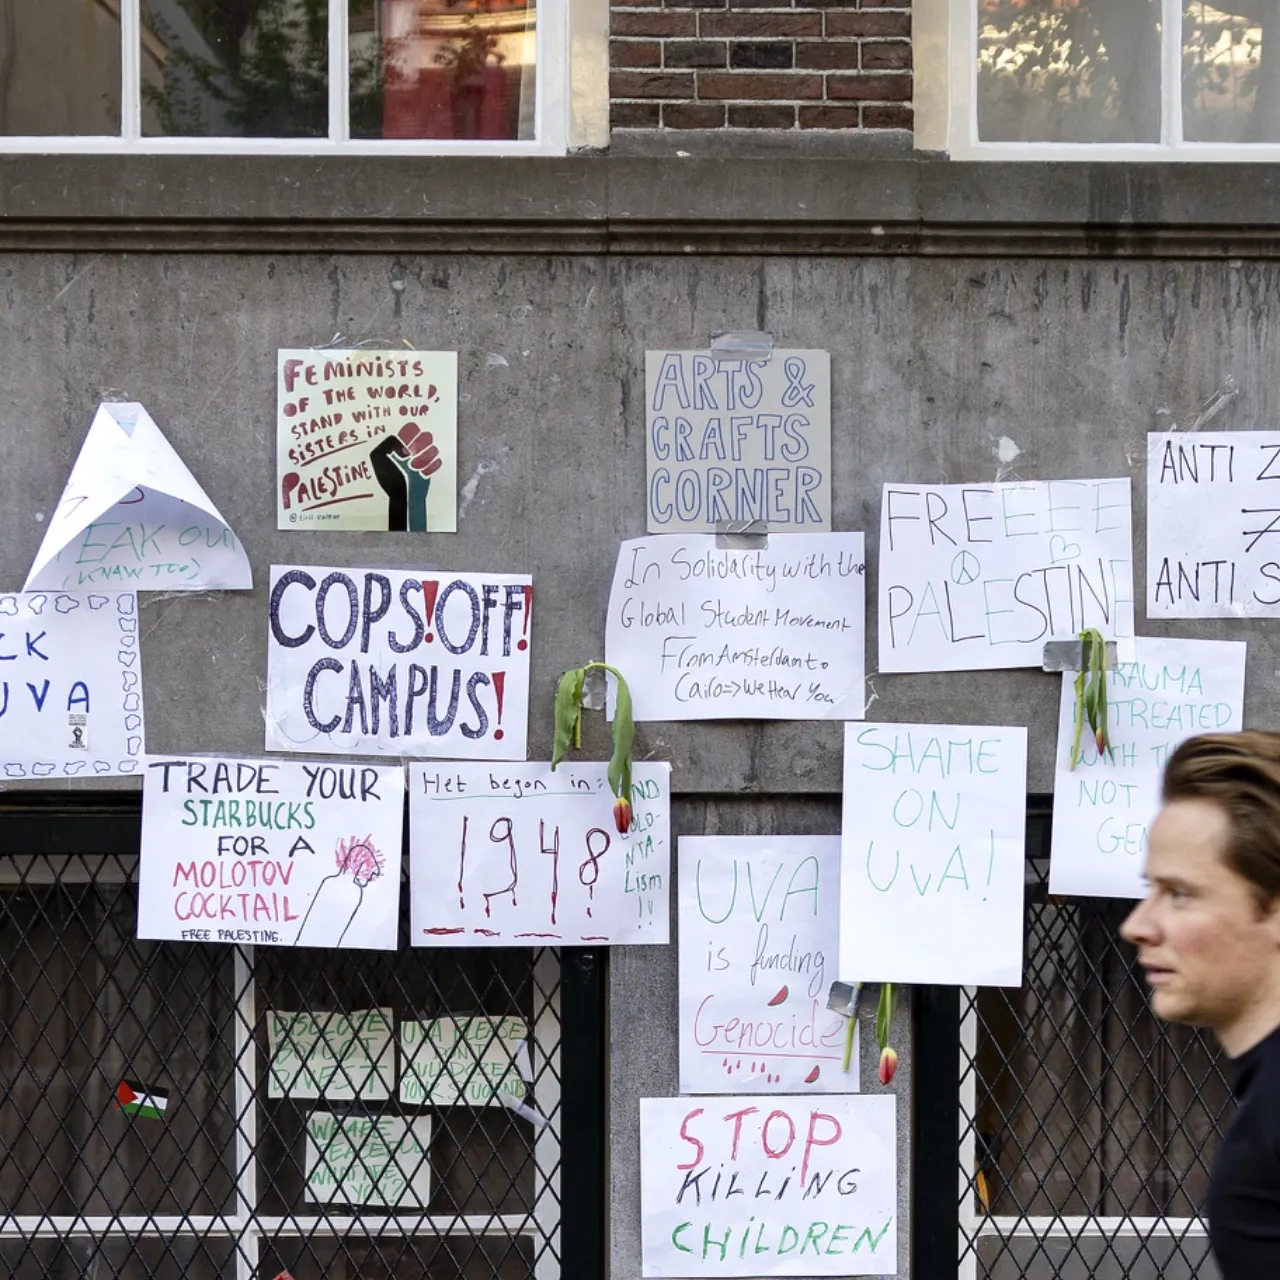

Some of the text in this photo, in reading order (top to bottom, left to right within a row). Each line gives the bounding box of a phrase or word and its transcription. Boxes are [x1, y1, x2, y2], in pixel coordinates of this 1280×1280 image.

[283, 384, 439, 417] OF THE WORLD,
[653, 354, 814, 411] ARTS &
[291, 413, 343, 440] STAND
[399, 404, 429, 416] OUR
[652, 414, 810, 462] CRAFTS
[1161, 440, 1234, 483] ANTI
[650, 468, 822, 523] CORNER
[672, 547, 866, 592] Solidarity with the
[1155, 557, 1235, 604] ANTI
[621, 598, 851, 632] Global Student Movement
[888, 558, 1132, 647] PALESTINE
[804, 654, 829, 670] to
[305, 657, 505, 741] CAMPUS!
[1108, 699, 1232, 729] TREATED
[858, 728, 1001, 778] SHAME
[149, 762, 381, 801] TRADE YOUR
[424, 772, 466, 793] Het
[1078, 780, 1138, 807] NOT
[181, 801, 316, 830] STARBUCKS
[893, 789, 960, 831] ON
[218, 836, 315, 857] FOR A
[173, 862, 294, 889] MOLOTOV
[457, 816, 612, 923] 1948
[696, 855, 819, 924] UVA
[174, 892, 299, 923] COCKTAIL
[181, 931, 213, 941] FREE
[708, 923, 824, 997] is funding
[694, 995, 844, 1048] Genocide
[677, 1106, 842, 1188] STOP
